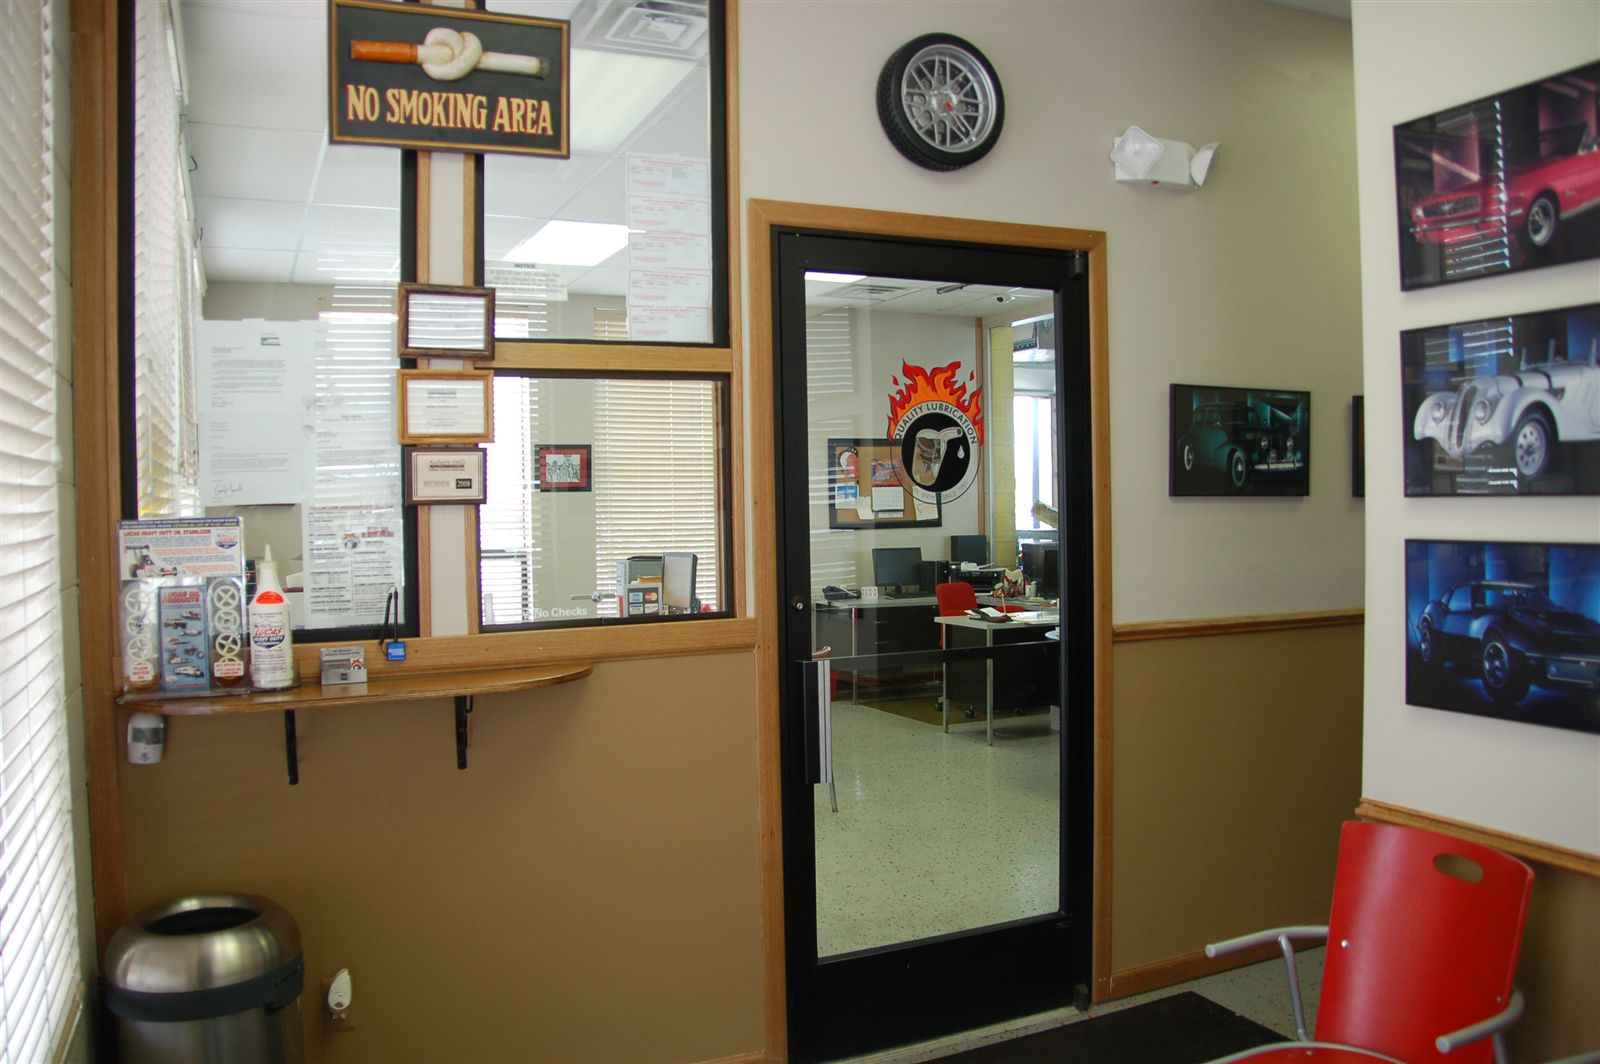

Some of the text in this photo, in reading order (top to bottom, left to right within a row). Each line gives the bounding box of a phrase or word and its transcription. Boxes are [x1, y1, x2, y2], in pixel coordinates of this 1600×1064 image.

[346, 84, 554, 136] NO SMOKING AREA
[894, 402, 977, 444] QUALITY LUBRICATION
[533, 608, 549, 618] No
[551, 606, 588, 618] Checks
[255, 628, 282, 636] LUCAS
